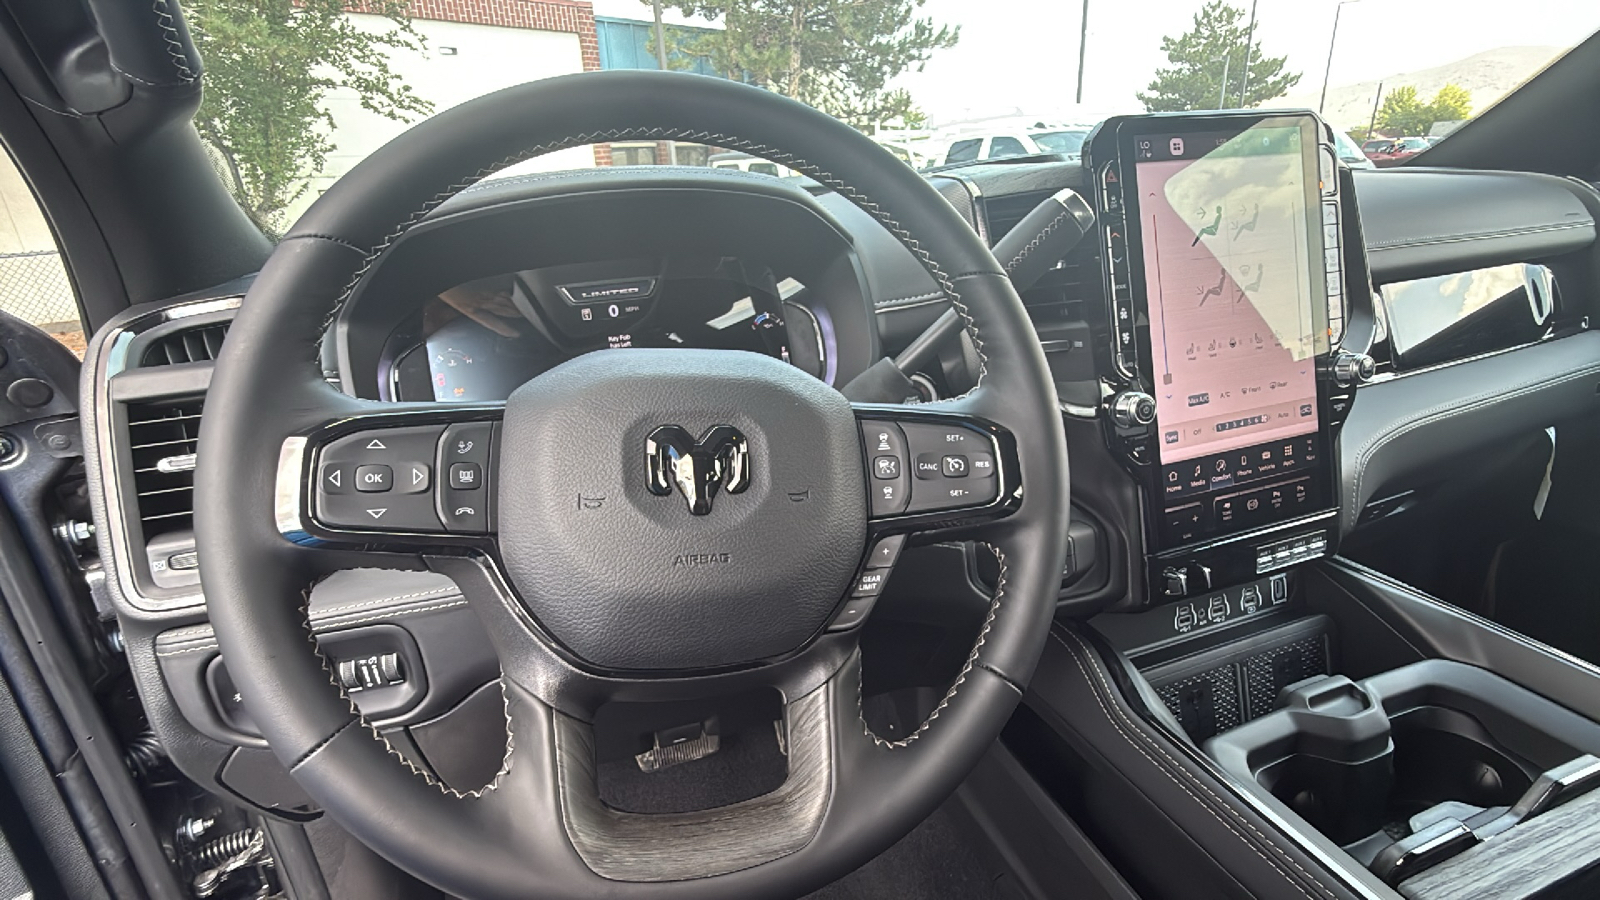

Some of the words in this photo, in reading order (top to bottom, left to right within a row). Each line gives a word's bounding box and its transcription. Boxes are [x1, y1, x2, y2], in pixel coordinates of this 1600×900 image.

[581, 287, 639, 298] LIMITED
[608, 304, 619, 318] 0
[919, 462, 938, 471] CANC
[975, 460, 990, 468] RES
[1257, 463, 1276, 472] Vehicle
[1236, 468, 1253, 477] Phone
[364, 473, 383, 484] OK
[1211, 472, 1232, 483] Comfort
[1190, 479, 1206, 488] Media
[1166, 484, 1183, 493] Home
[674, 553, 731, 566] AIRBAG
